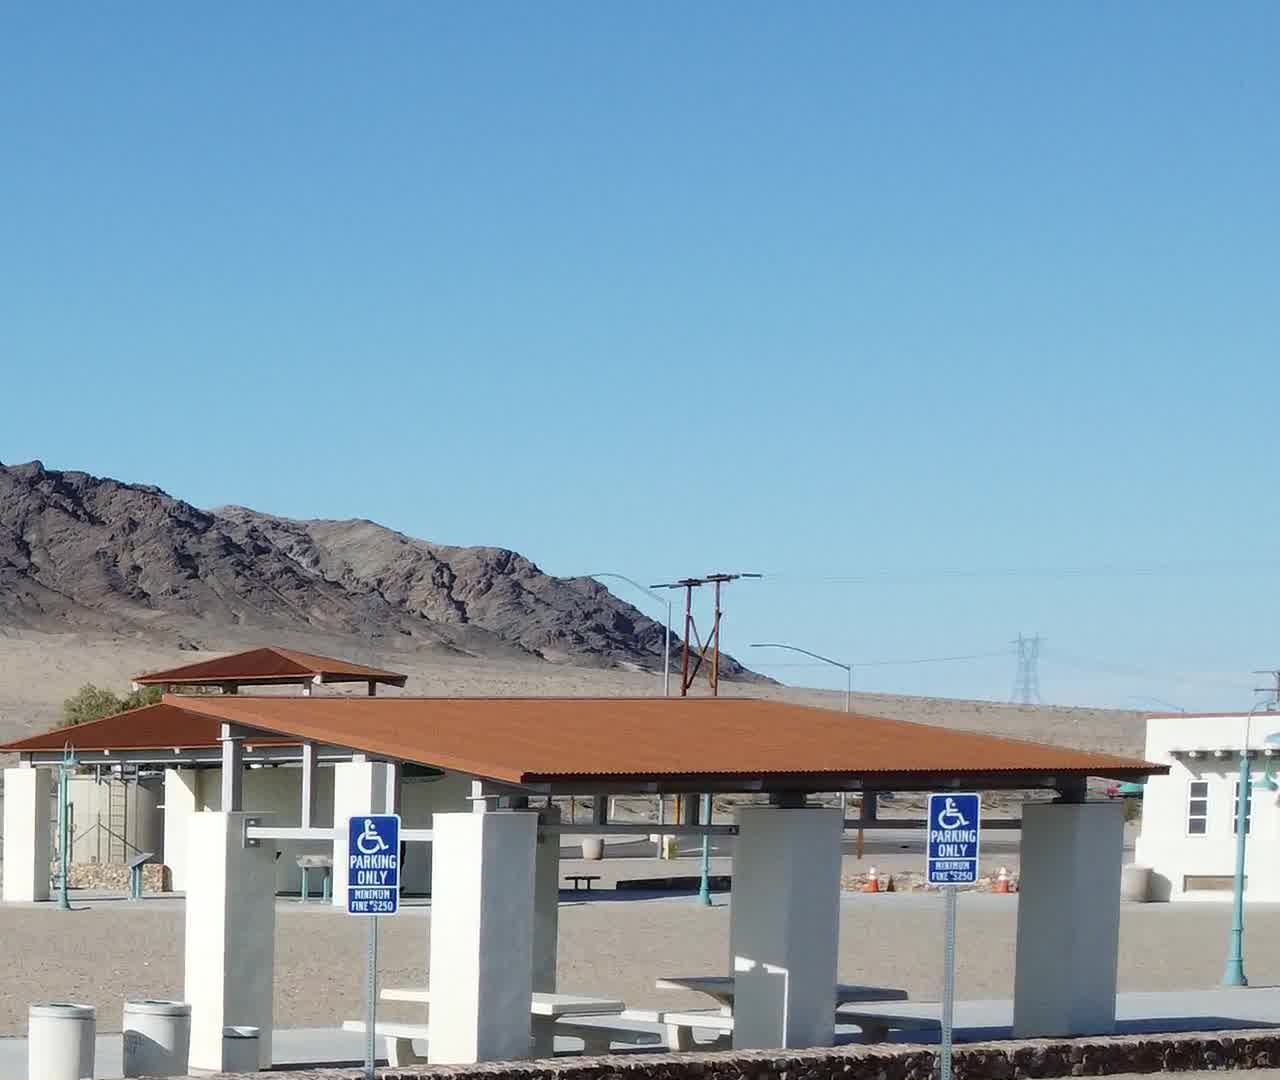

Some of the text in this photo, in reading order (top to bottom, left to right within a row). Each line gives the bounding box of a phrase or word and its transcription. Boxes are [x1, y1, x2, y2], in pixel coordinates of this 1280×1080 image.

[931, 830, 976, 843] PARKING
[938, 844, 968, 857] ONLY
[350, 855, 396, 869] PARKING
[935, 861, 970, 870] MINIMUM
[357, 870, 388, 885] ONLY
[931, 871, 973, 881] FINE $250
[354, 889, 390, 899] MINIMUM
[351, 901, 393, 912] FINE $250
